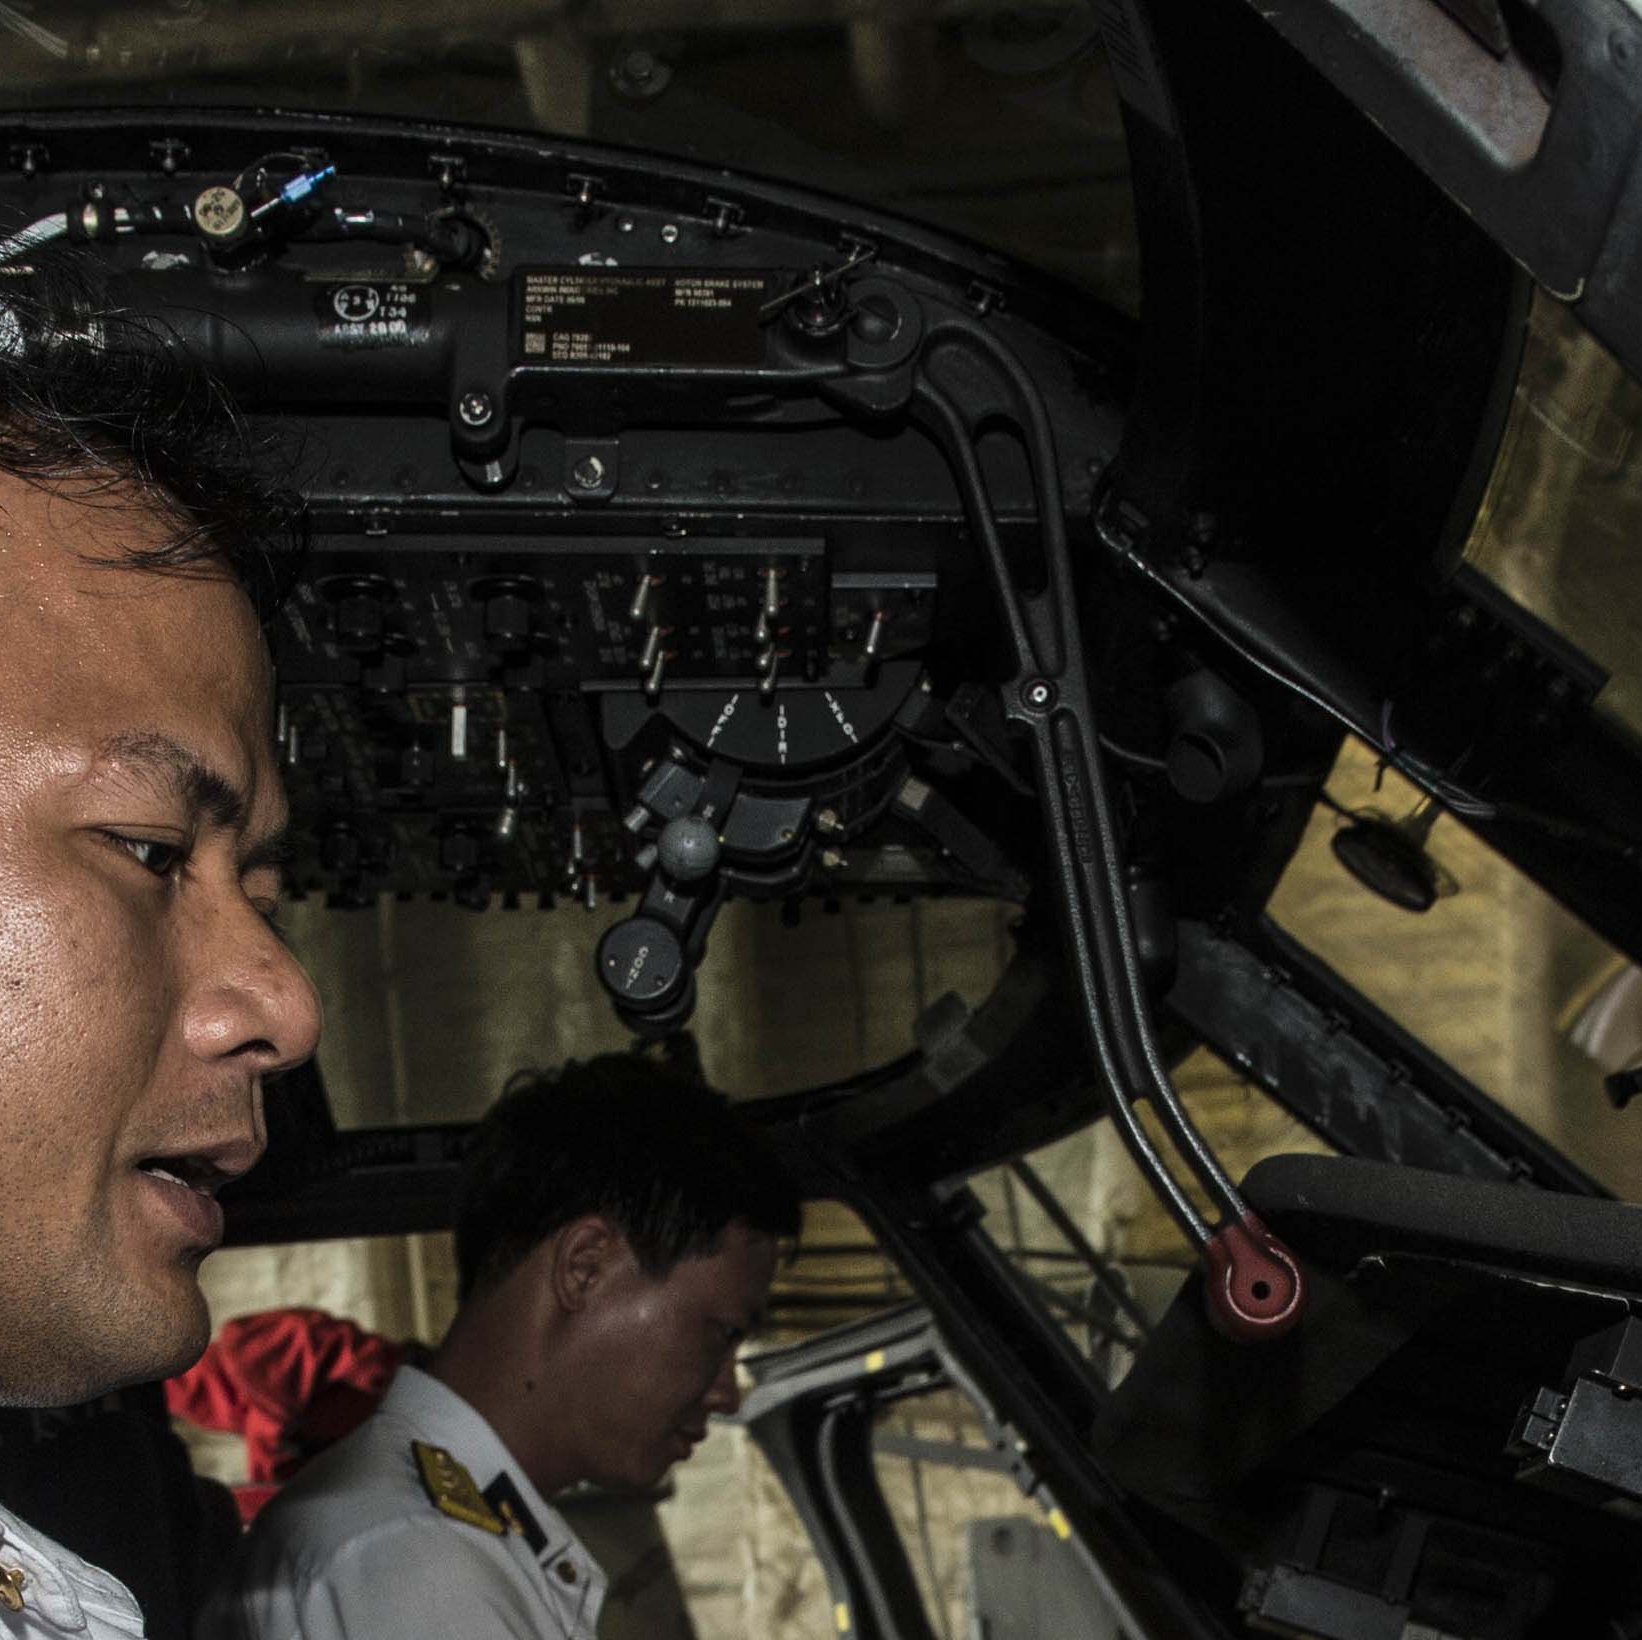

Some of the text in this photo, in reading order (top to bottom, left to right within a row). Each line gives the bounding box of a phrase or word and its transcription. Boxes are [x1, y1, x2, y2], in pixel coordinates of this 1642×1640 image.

[675, 279, 765, 289] ROTOR BRAKE SYSTEM
